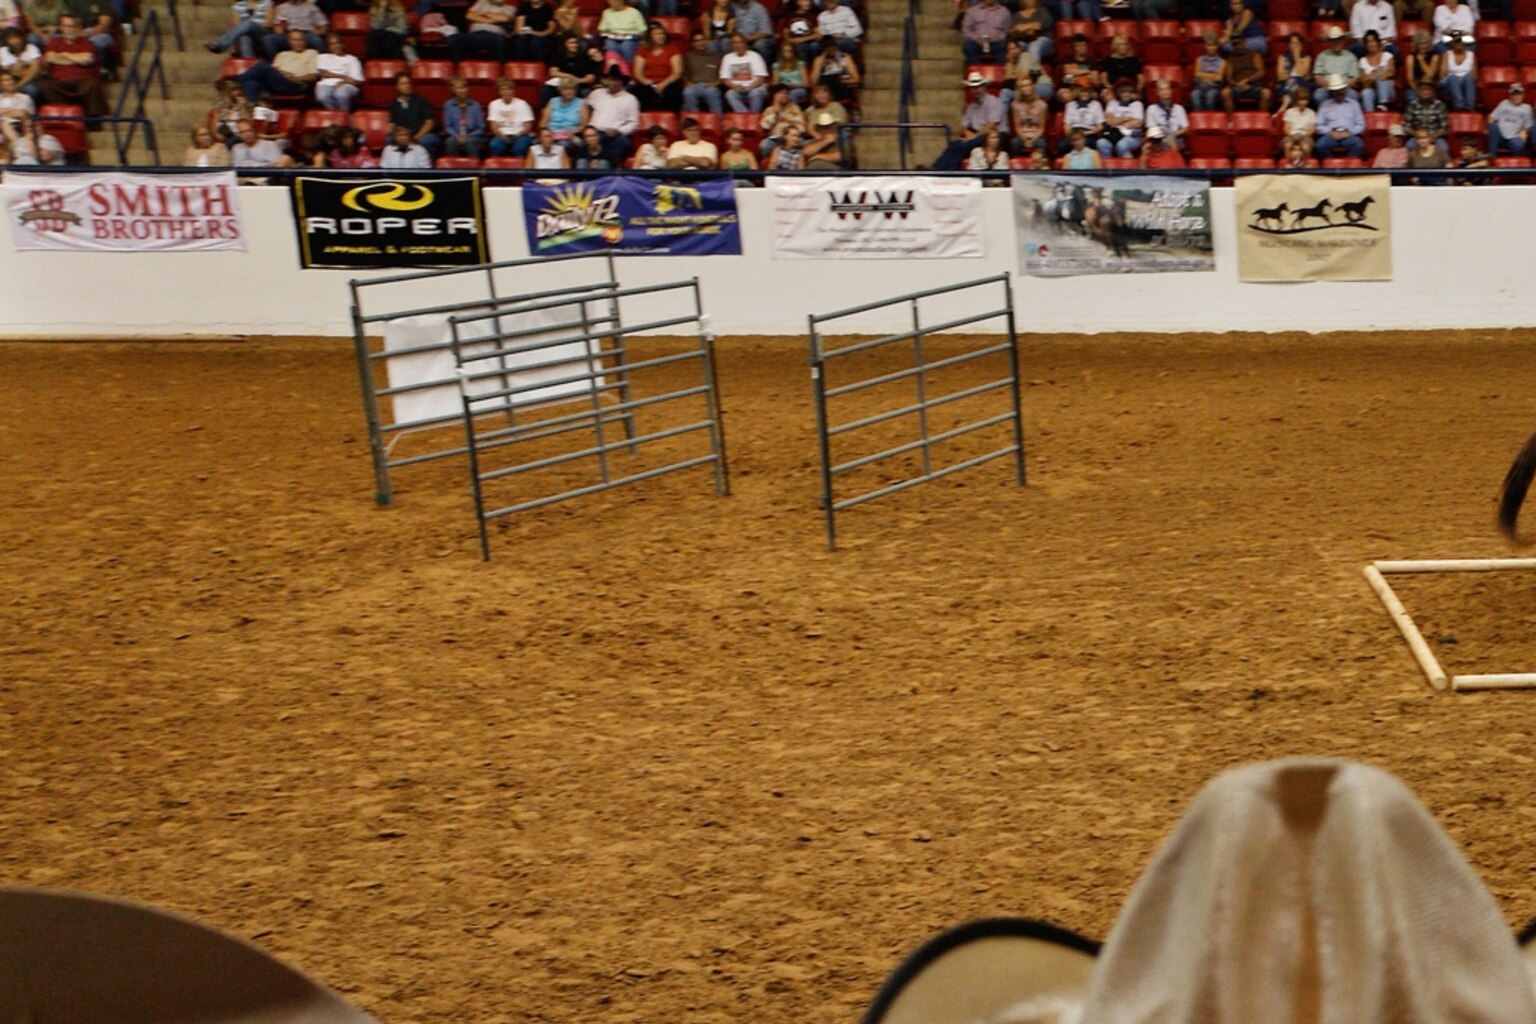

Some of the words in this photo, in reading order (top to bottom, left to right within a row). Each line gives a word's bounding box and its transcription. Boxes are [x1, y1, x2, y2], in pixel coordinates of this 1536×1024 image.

[88, 182, 234, 217] SMITH
[92, 218, 240, 240] BROTHERS
[305, 217, 478, 235] ROPER
